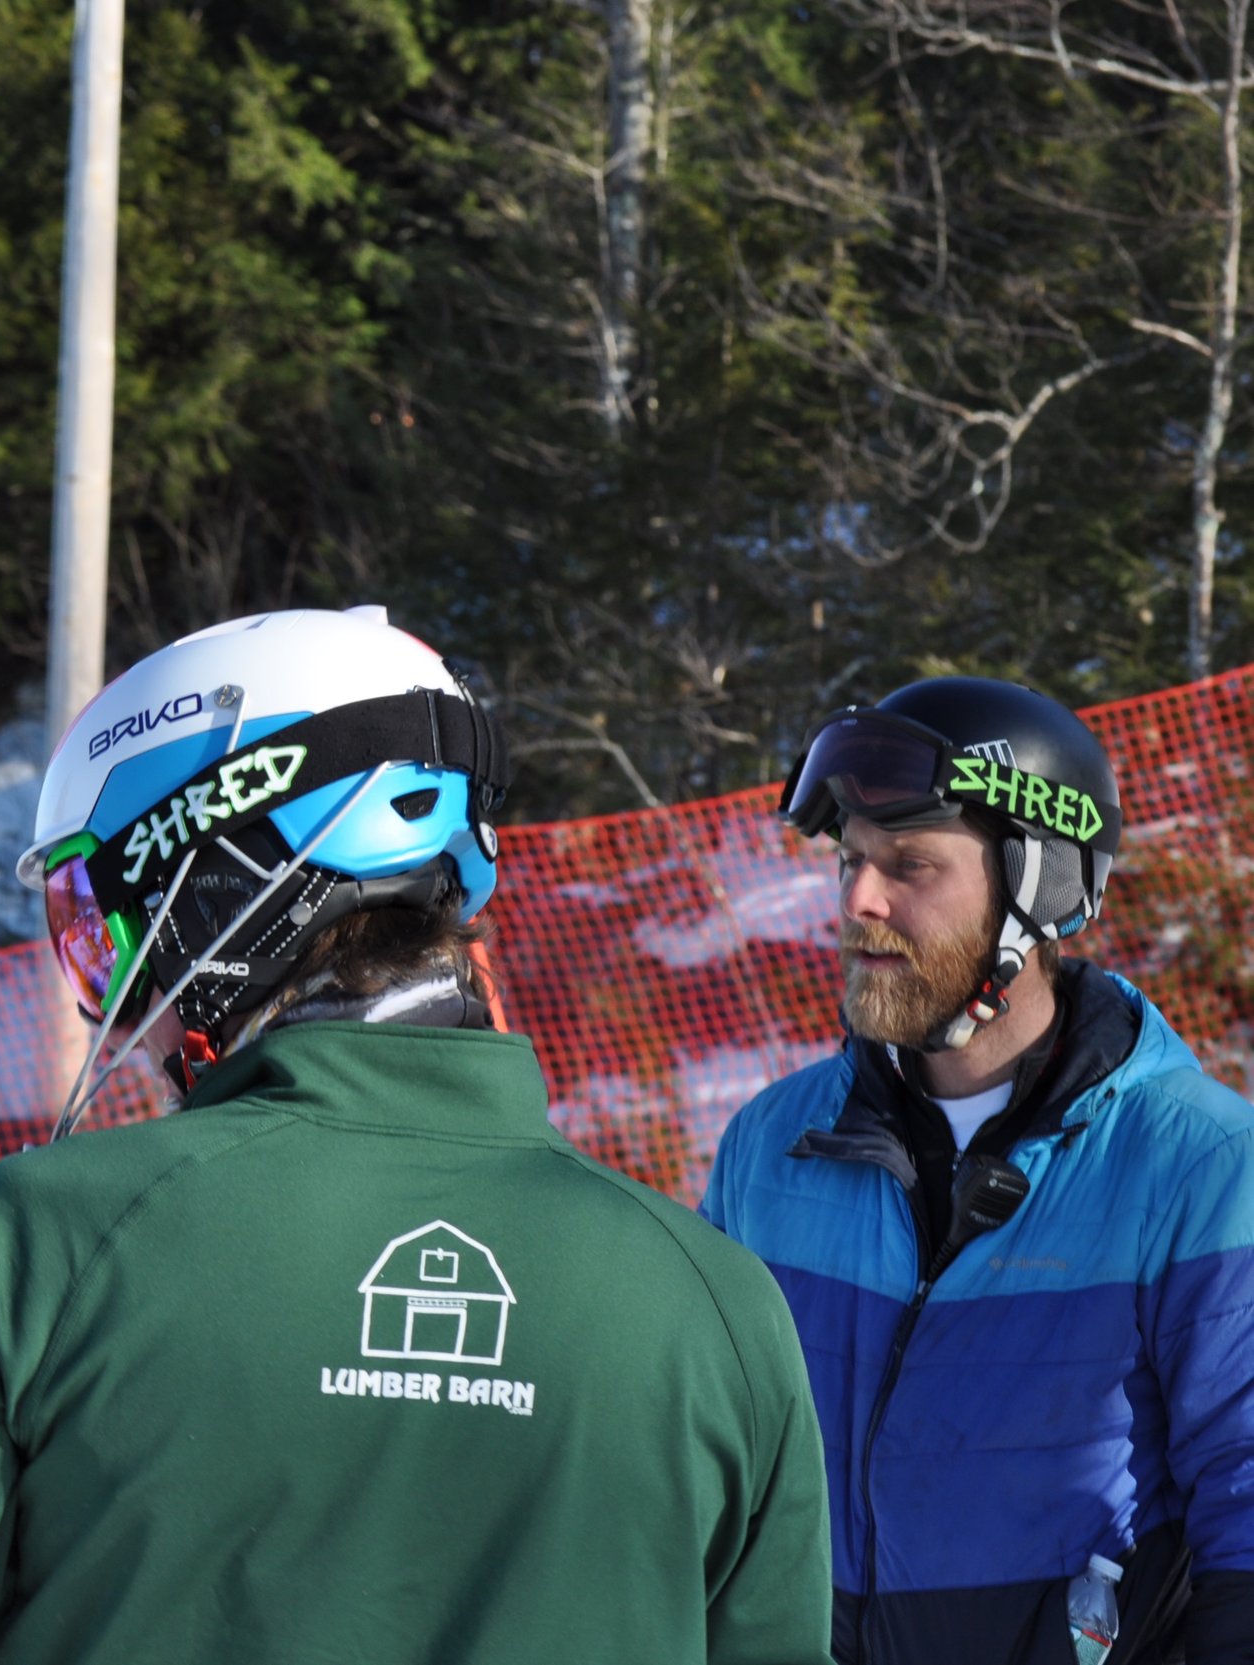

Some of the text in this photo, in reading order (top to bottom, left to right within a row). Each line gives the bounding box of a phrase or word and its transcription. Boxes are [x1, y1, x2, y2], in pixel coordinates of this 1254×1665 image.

[89, 692, 203, 761] BRIKO
[122, 744, 308, 884] SHRED
[950, 757, 1104, 842] SHRED
[320, 1367, 536, 1410] LUMBER BARN
